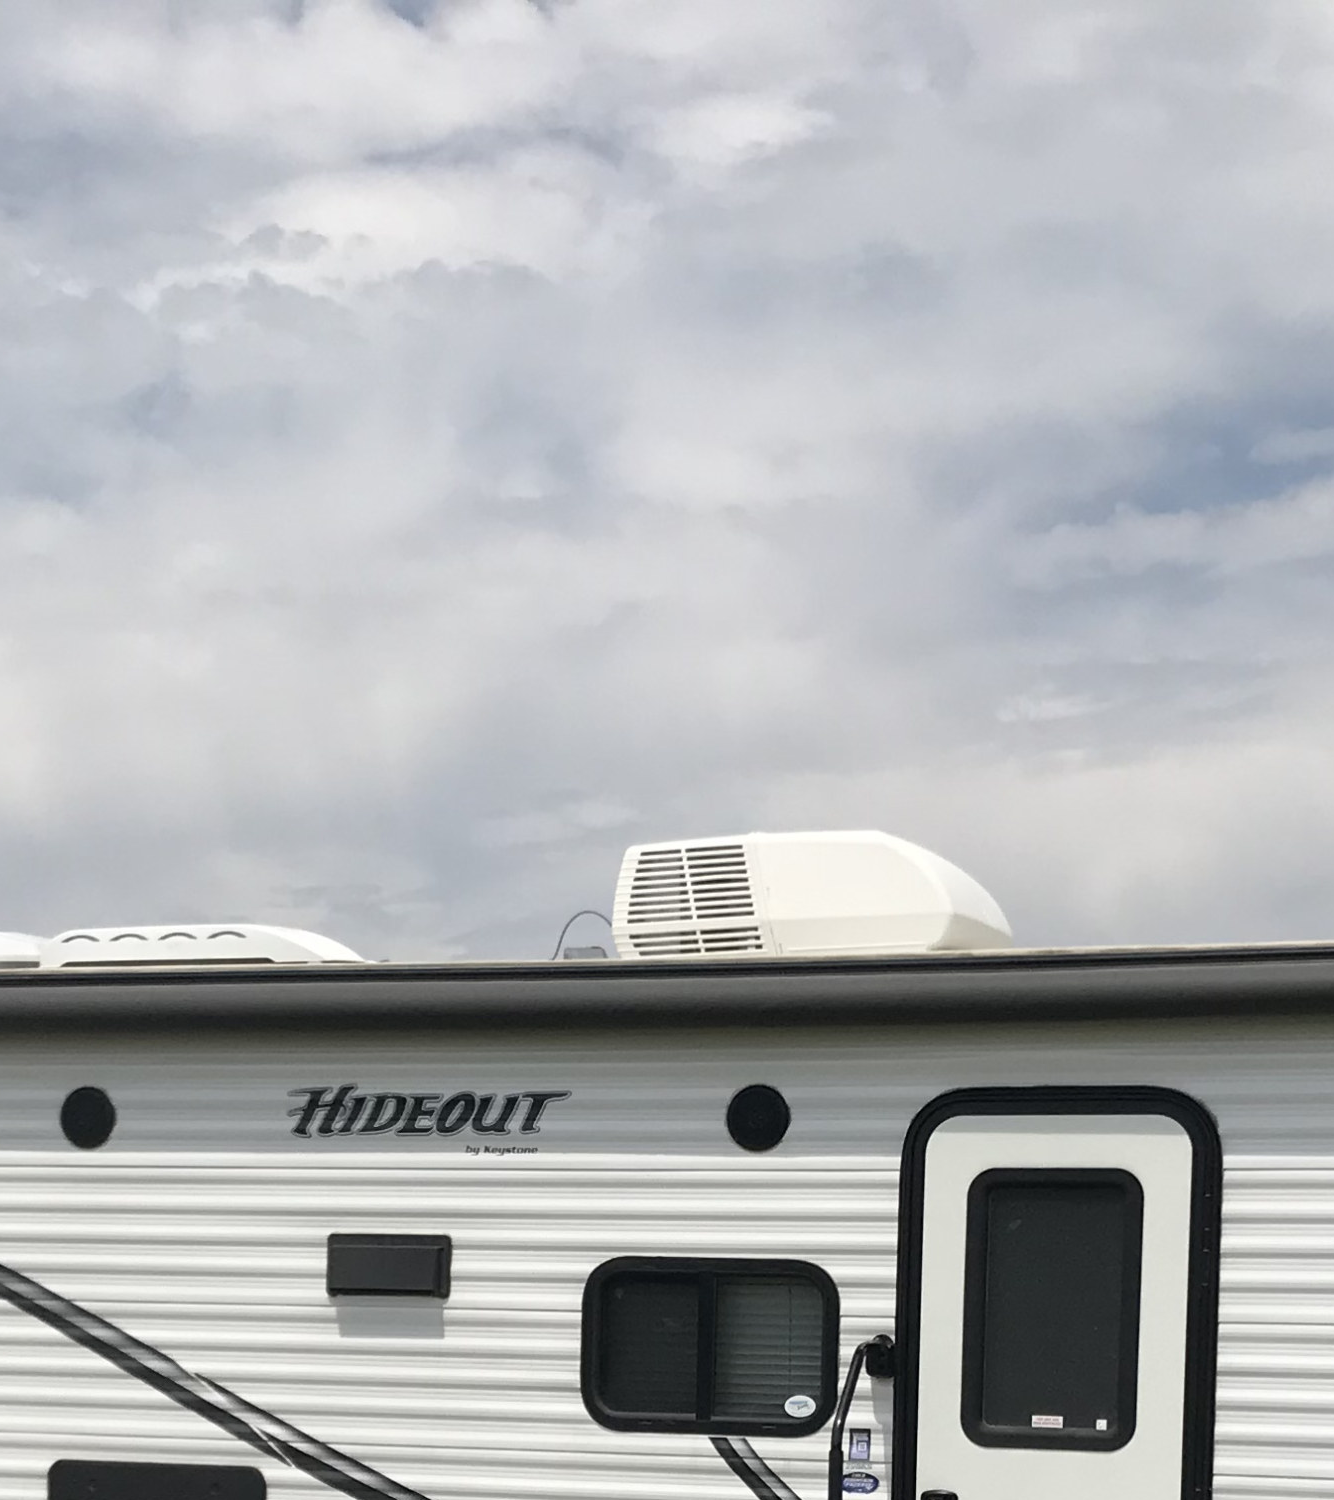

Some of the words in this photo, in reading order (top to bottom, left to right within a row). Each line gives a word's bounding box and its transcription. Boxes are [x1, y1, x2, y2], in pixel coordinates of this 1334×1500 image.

[287, 1084, 572, 1137] HIDEOUT
[465, 1145, 480, 1156] by
[484, 1145, 538, 1156] Keystone
